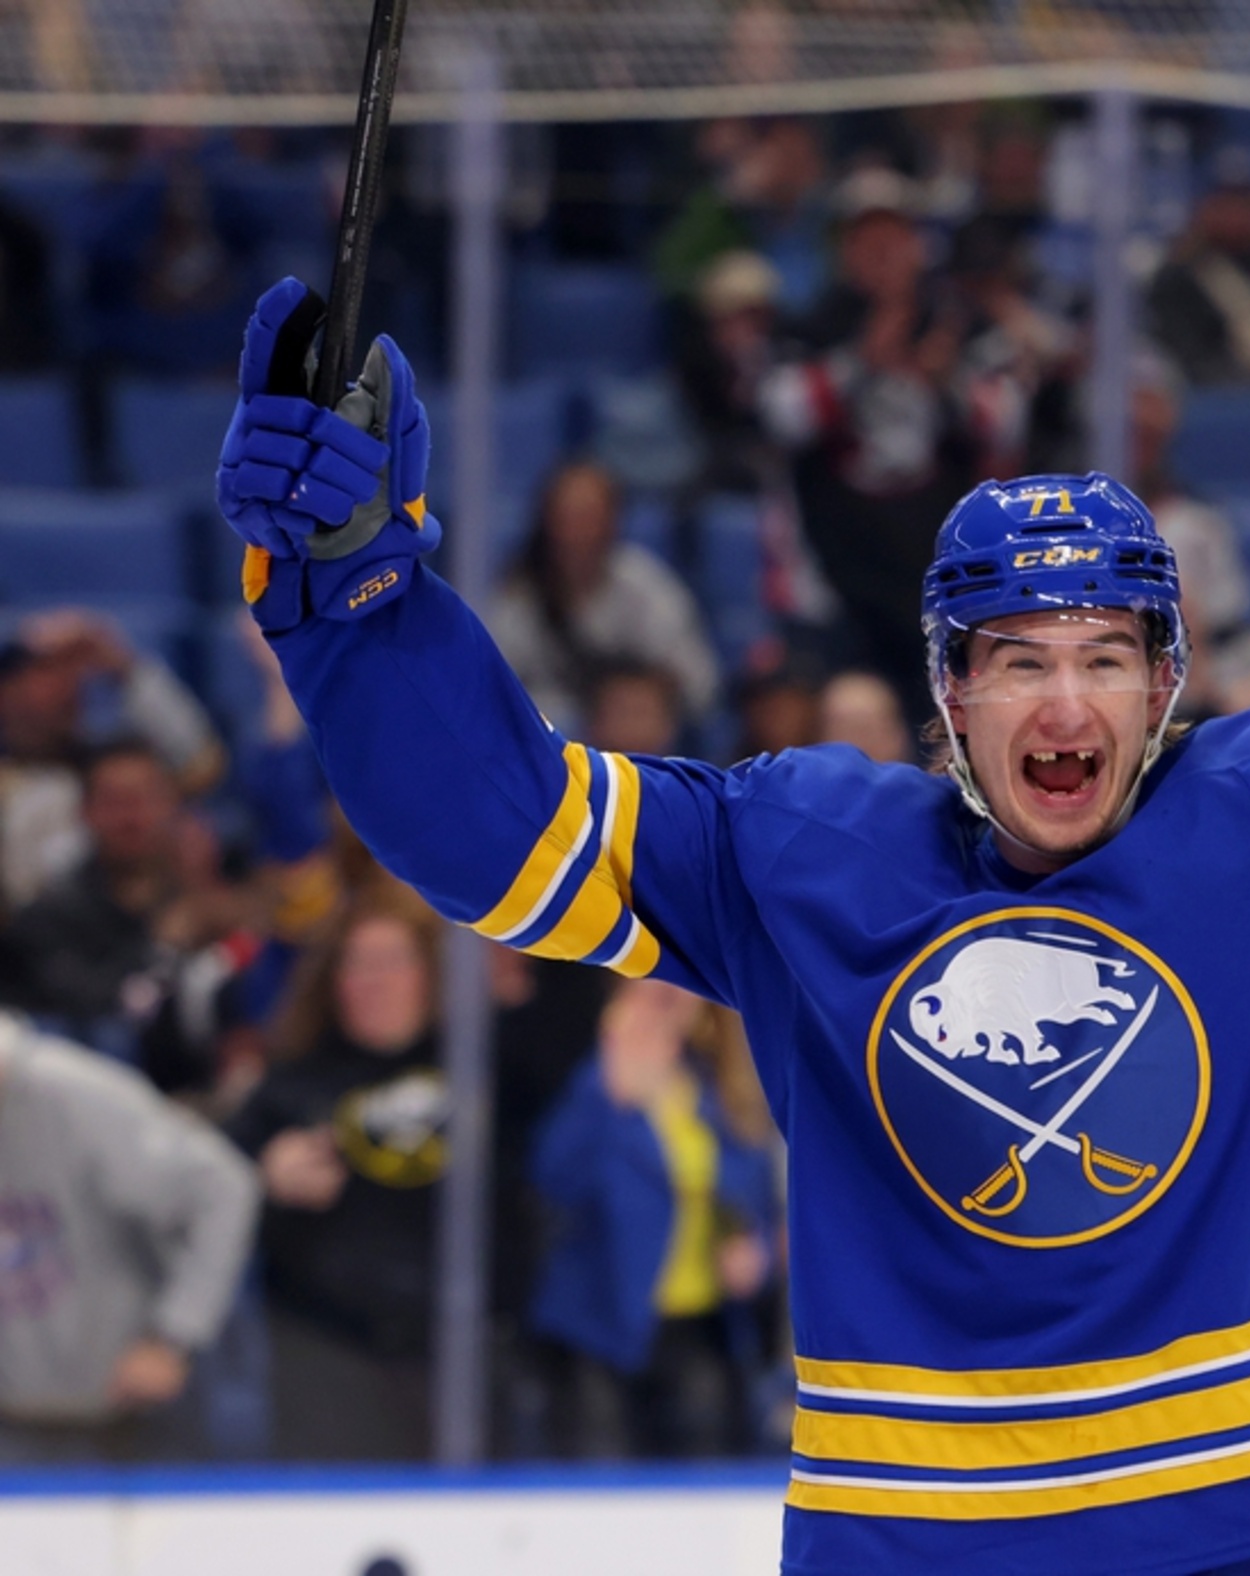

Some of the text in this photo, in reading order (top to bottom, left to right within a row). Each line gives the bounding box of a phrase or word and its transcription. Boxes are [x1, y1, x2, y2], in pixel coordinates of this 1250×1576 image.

[1020, 489, 1075, 516] 71
[1013, 546, 1101, 568] CCM
[348, 571, 399, 610] CCM
